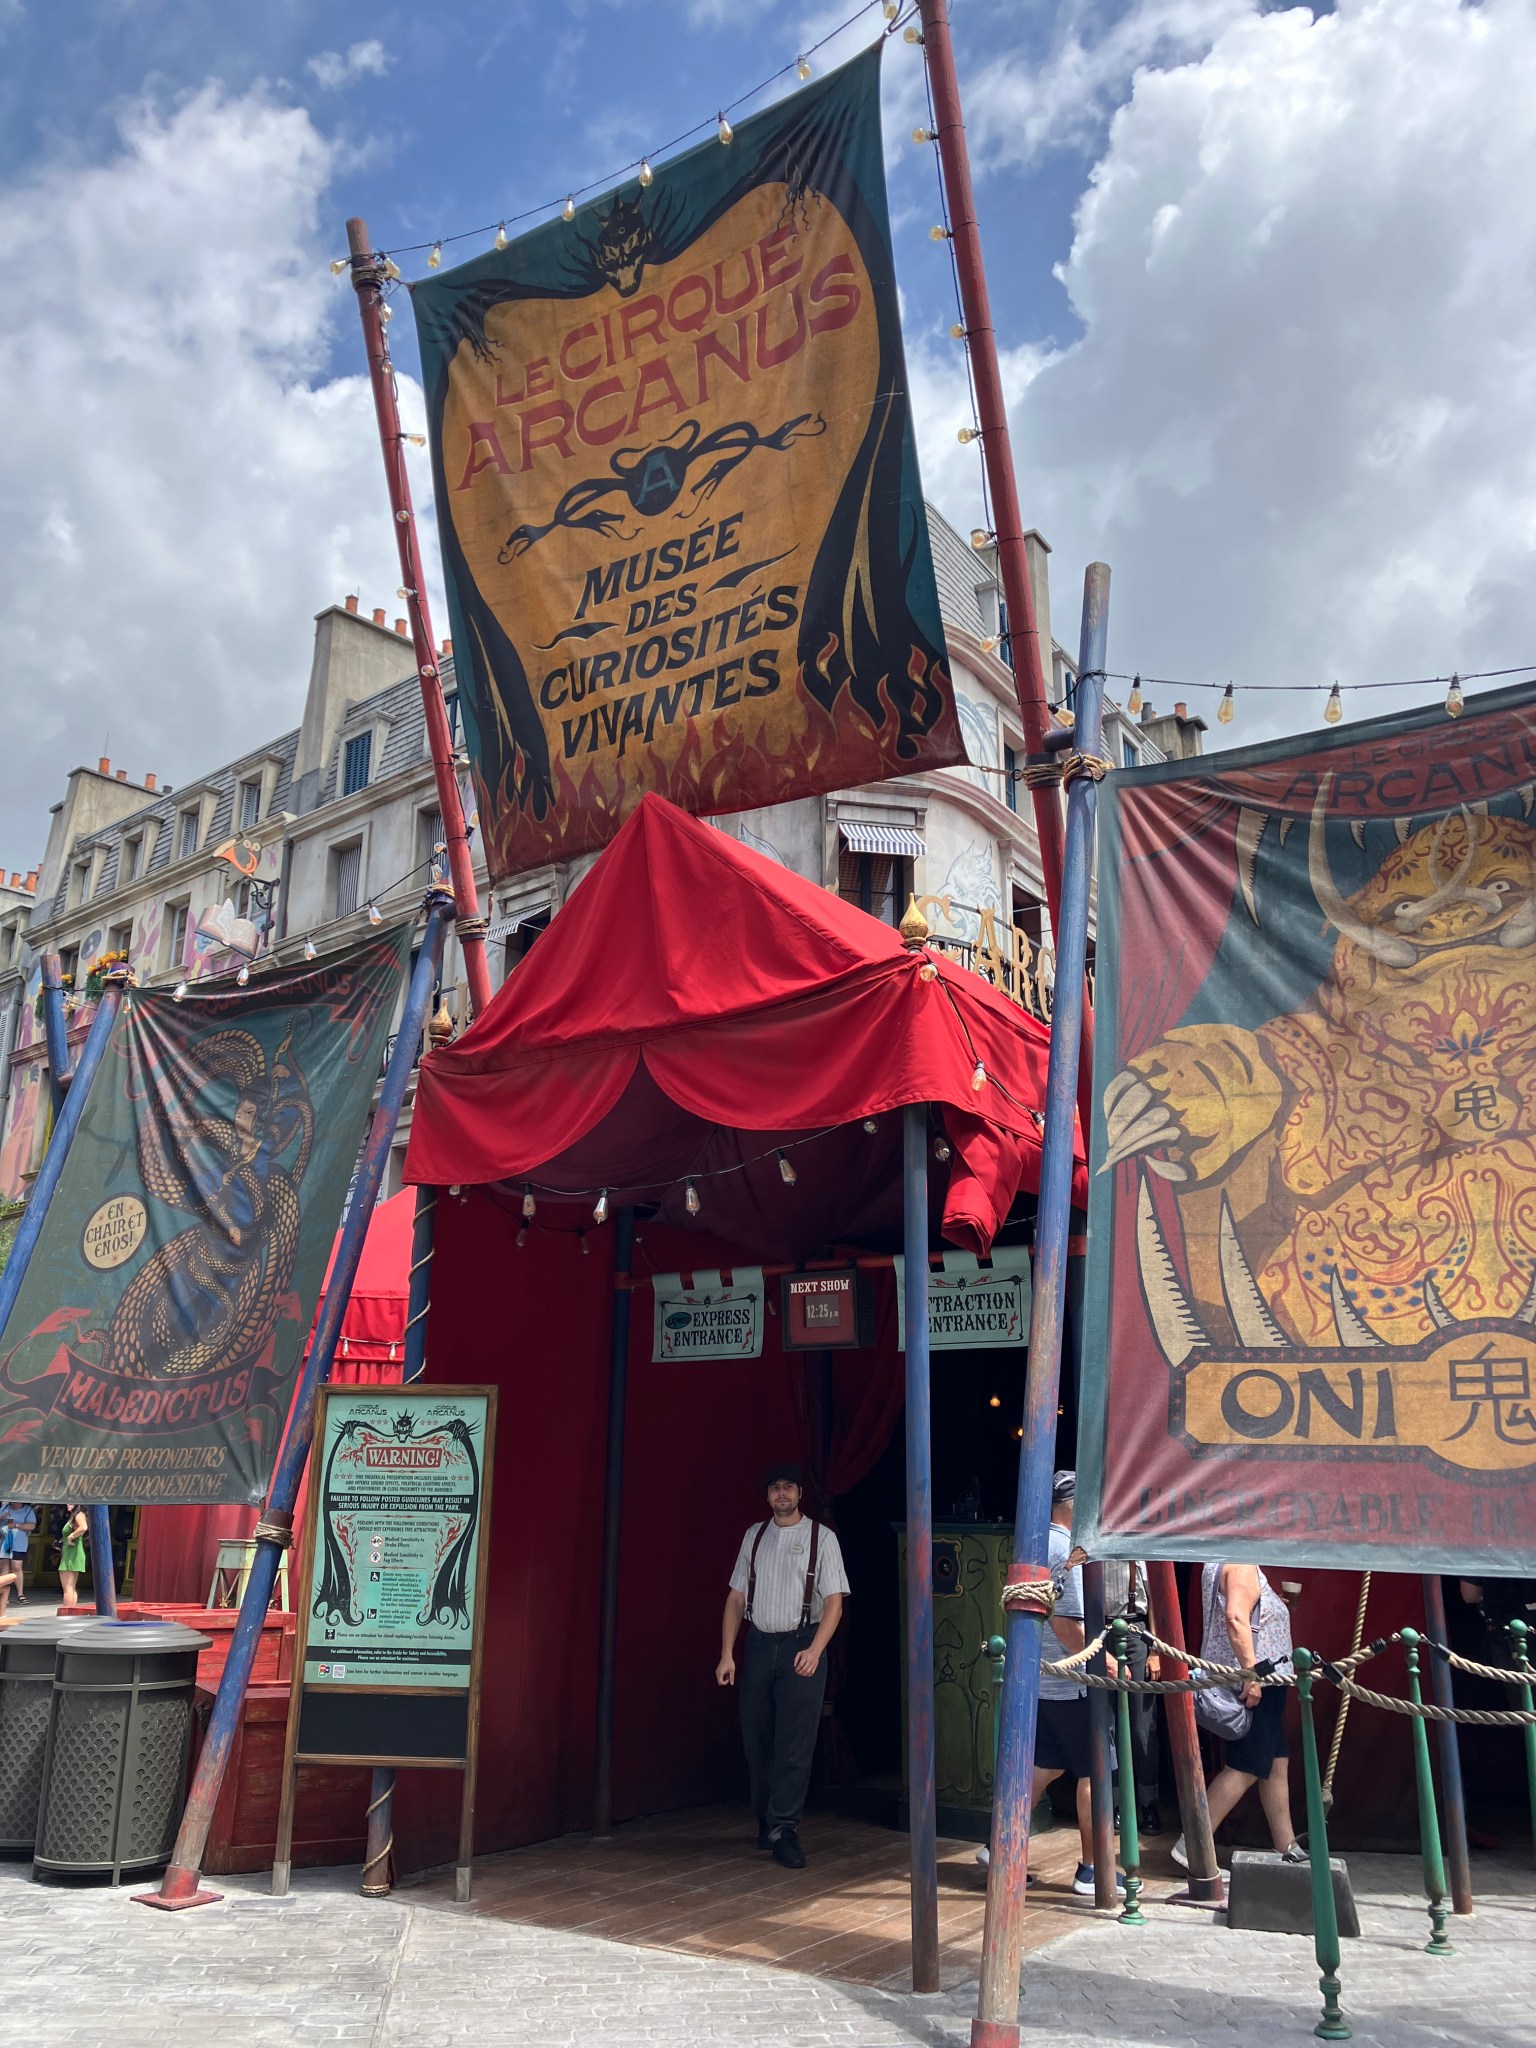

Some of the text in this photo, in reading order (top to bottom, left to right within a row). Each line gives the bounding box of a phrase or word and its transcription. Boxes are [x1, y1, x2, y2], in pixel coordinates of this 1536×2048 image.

[495, 222, 804, 408] LE CIRQUE
[457, 252, 862, 492] ARCANUS
[573, 511, 744, 621] MUSÉE
[624, 582, 699, 637] DES
[540, 584, 799, 710] CURIOSITÉS
[561, 650, 781, 759] VIVANTES
[1352, 747, 1392, 768] LE
[1446, 1080, 1506, 1132] 鬼
[107, 1202, 124, 1220] EN
[85, 1212, 144, 1243] CHAIR ET
[94, 1231, 133, 1258] EN OS!
[790, 1279, 849, 1294] NEXT SHOW
[806, 1304, 829, 1319] 12:25
[928, 1292, 1015, 1313] TRACTION
[693, 1309, 750, 1327] EXPRESS
[674, 1328, 743, 1347] ENTRANCE
[348, 1408, 388, 1416] ARCANUS
[1221, 1367, 1397, 1440] ONI
[40, 1445, 228, 1470] VENU DES PROFONDEURS
[368, 1449, 440, 1466] WARNING!
[9, 1472, 228, 1500] DE LA JUNGLE INDONÉSIENNE
